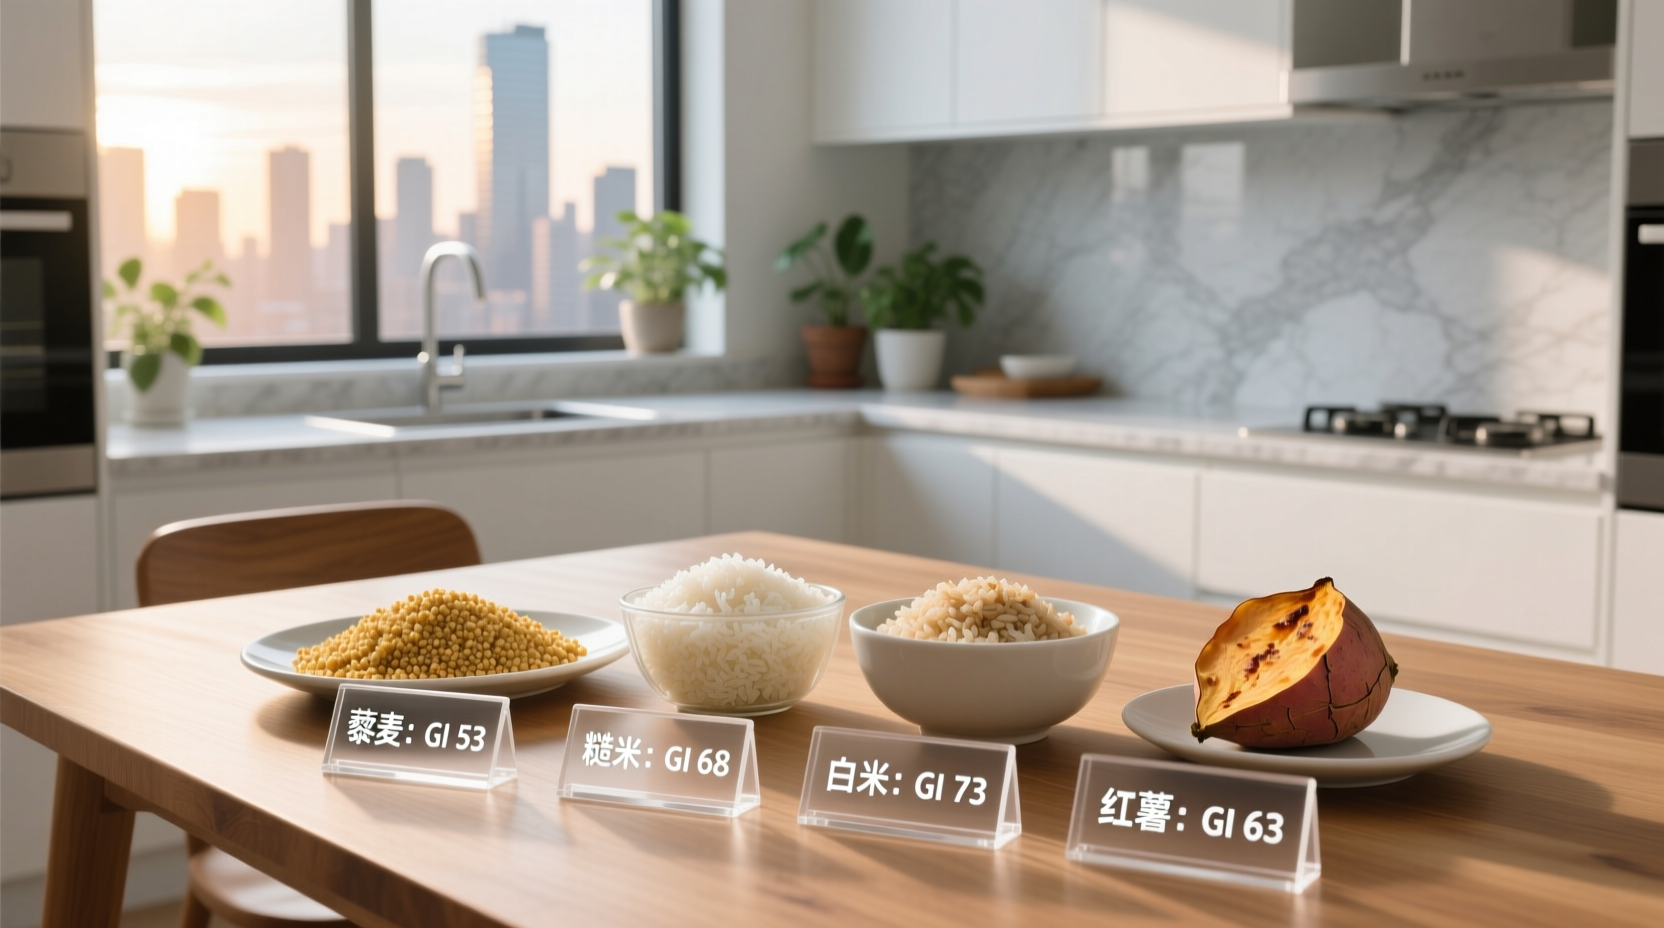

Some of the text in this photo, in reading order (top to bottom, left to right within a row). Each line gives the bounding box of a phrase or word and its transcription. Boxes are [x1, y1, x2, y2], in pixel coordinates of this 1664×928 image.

[424, 721, 451, 748] GI
[455, 724, 486, 752] 53
[664, 745, 692, 773] GI
[697, 748, 731, 777] 68
[826, 756, 987, 806] 白米： GI 73
[1098, 787, 1284, 844] 红薯： GI 63
